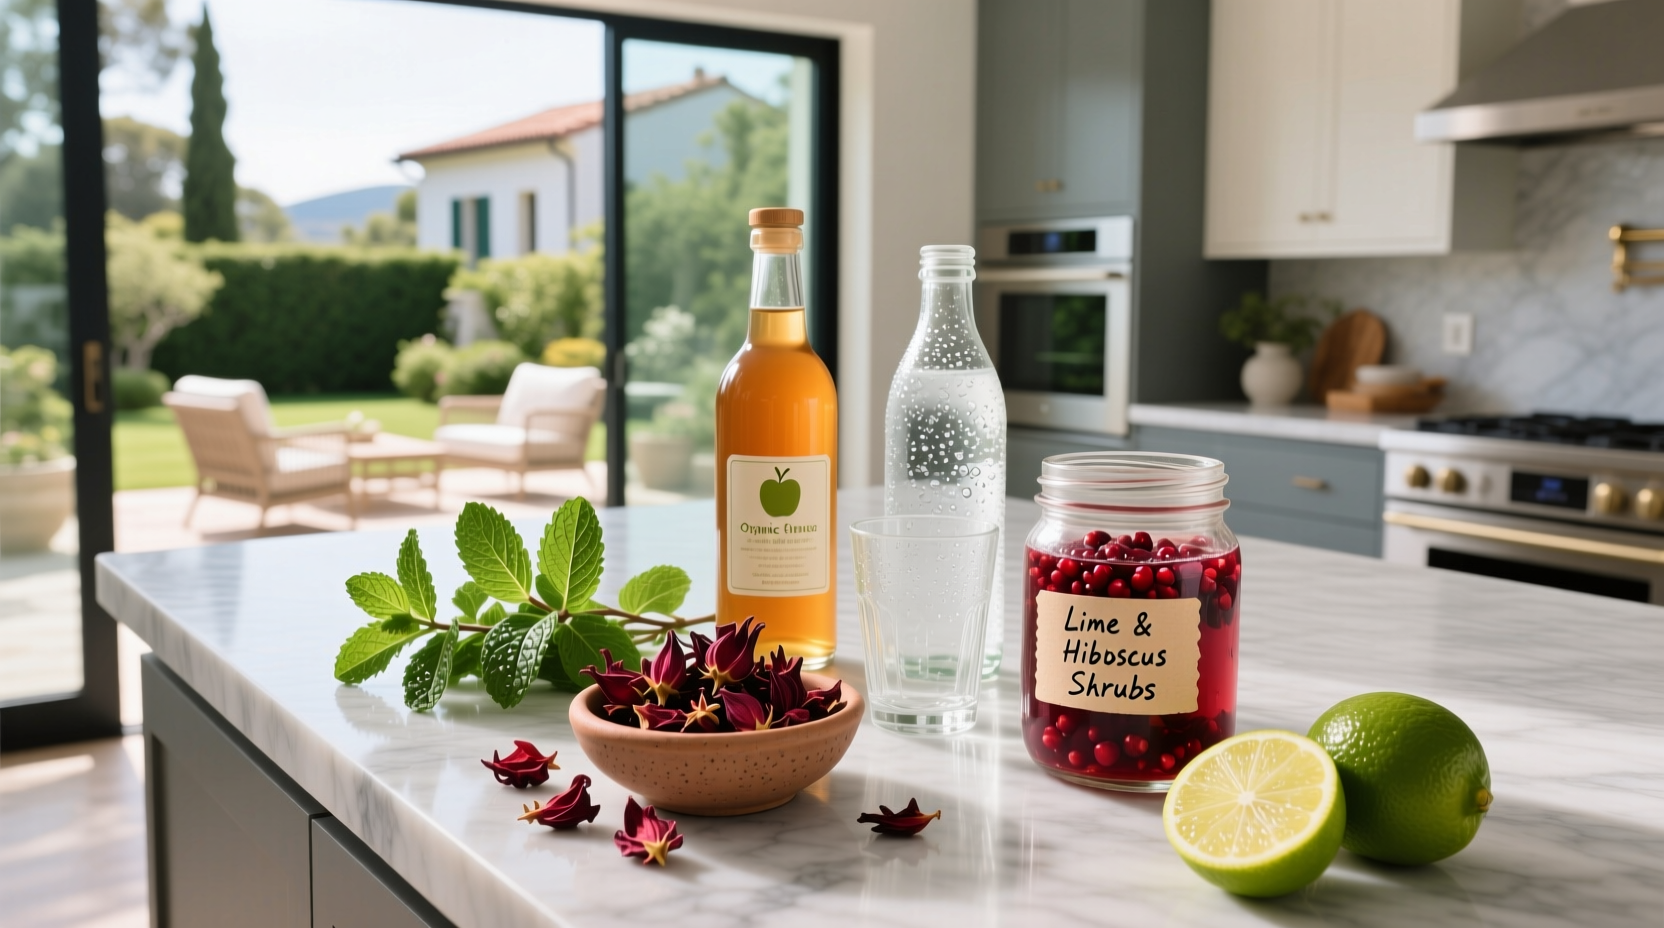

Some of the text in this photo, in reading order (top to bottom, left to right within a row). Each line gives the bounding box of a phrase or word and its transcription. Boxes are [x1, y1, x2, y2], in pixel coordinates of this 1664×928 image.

[1064, 605, 1152, 637] Lime &
[1063, 638, 1167, 667] Hiboscus
[1068, 670, 1156, 700] Shrubs
